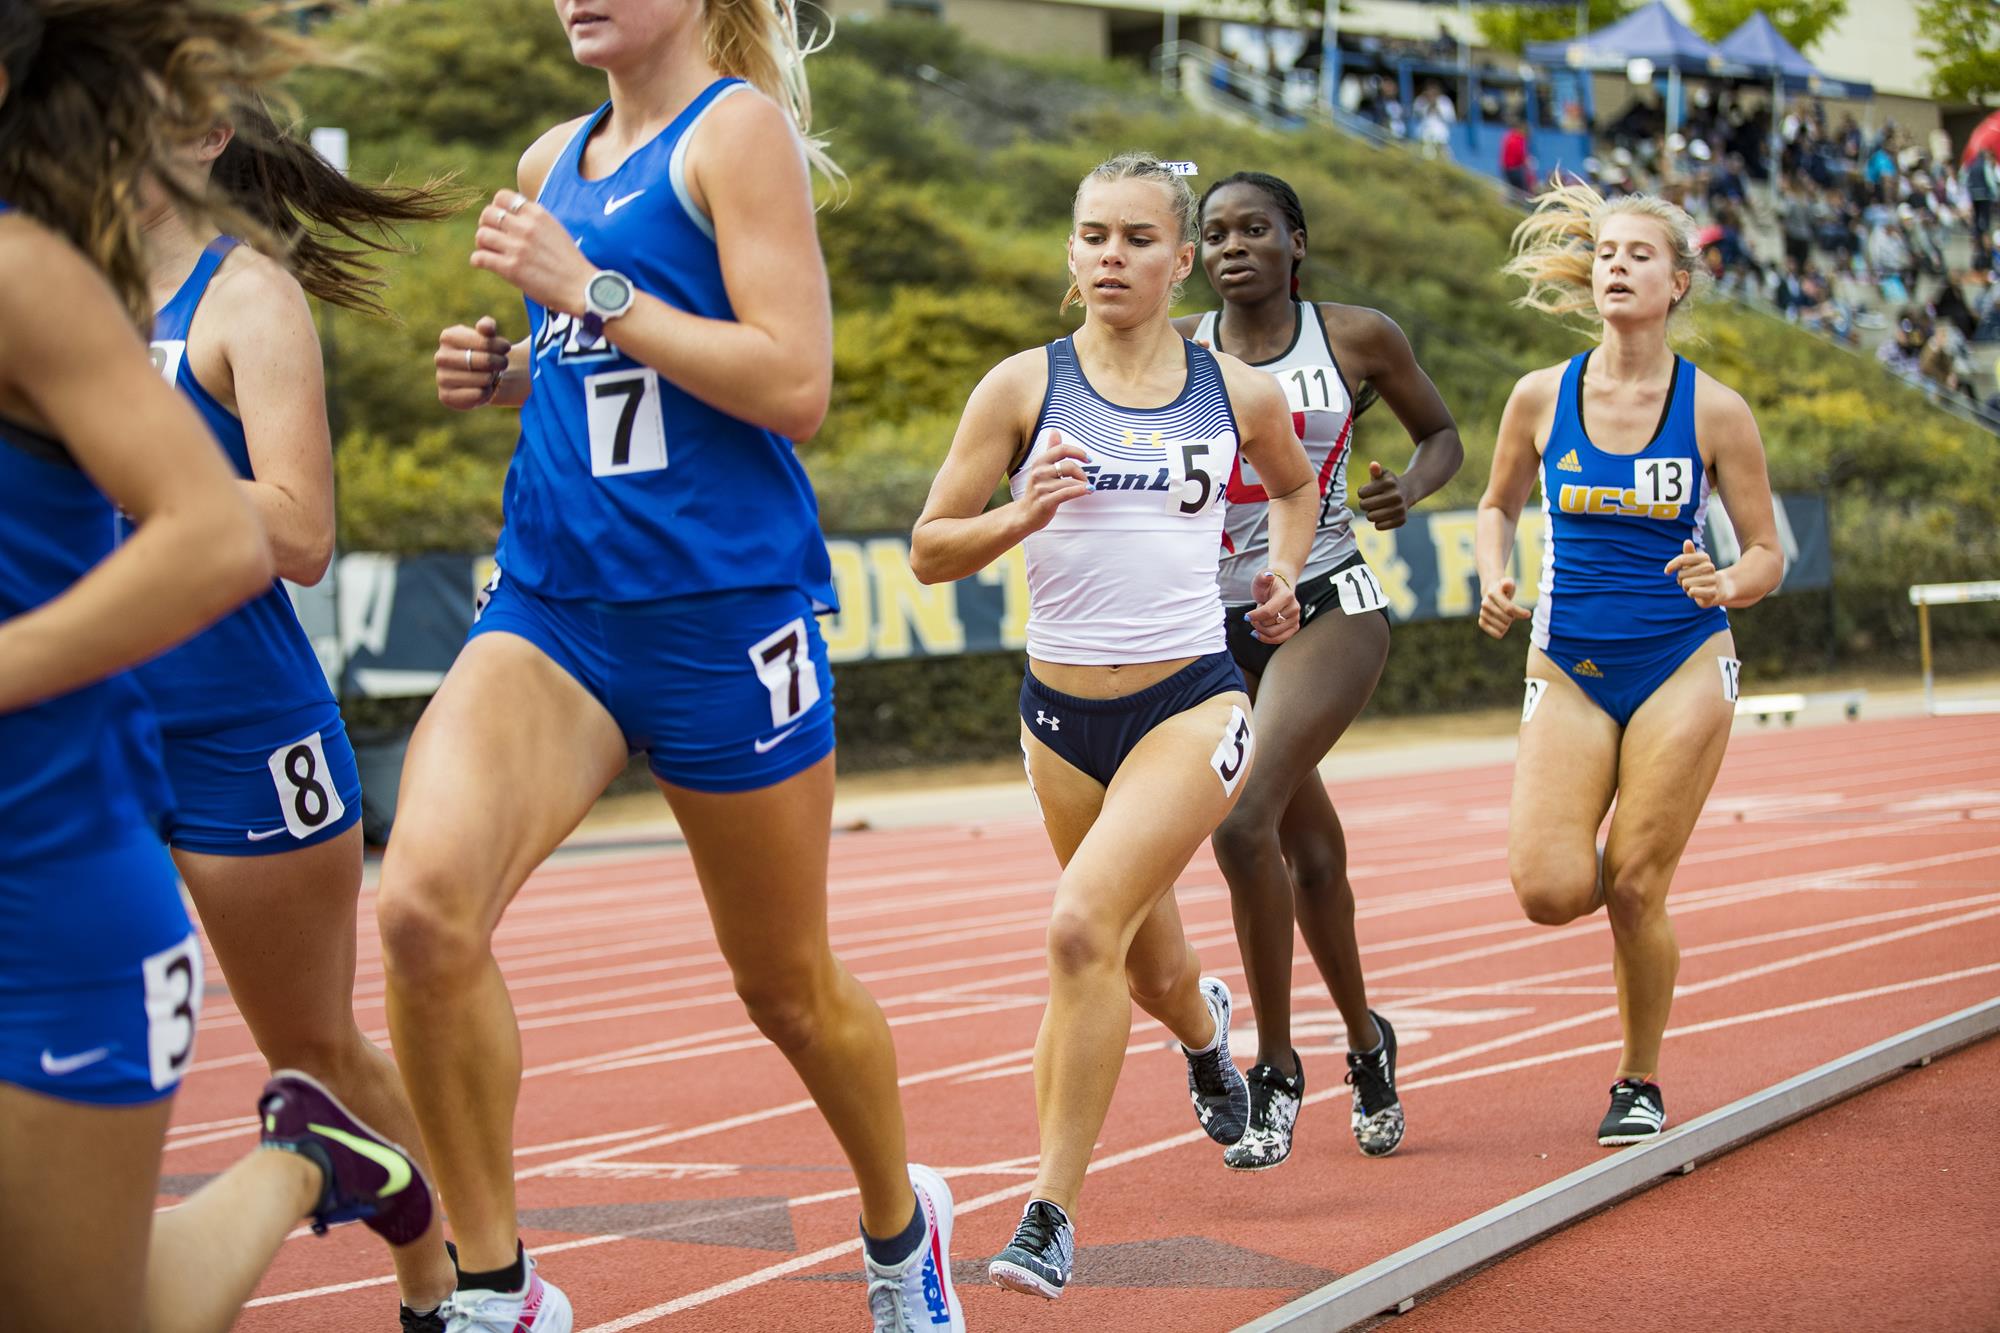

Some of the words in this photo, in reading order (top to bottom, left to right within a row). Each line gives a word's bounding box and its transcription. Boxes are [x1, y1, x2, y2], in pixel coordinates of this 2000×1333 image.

[595, 378, 645, 466] 7
[1291, 368, 1329, 408] 11
[1179, 444, 1211, 514] 5
[1645, 461, 1682, 502] 13
[1345, 567, 1379, 608] 11
[760, 629, 800, 718] 7
[1220, 717, 1250, 782] 5
[285, 744, 329, 826] 8
[165, 955, 194, 1070] 3
